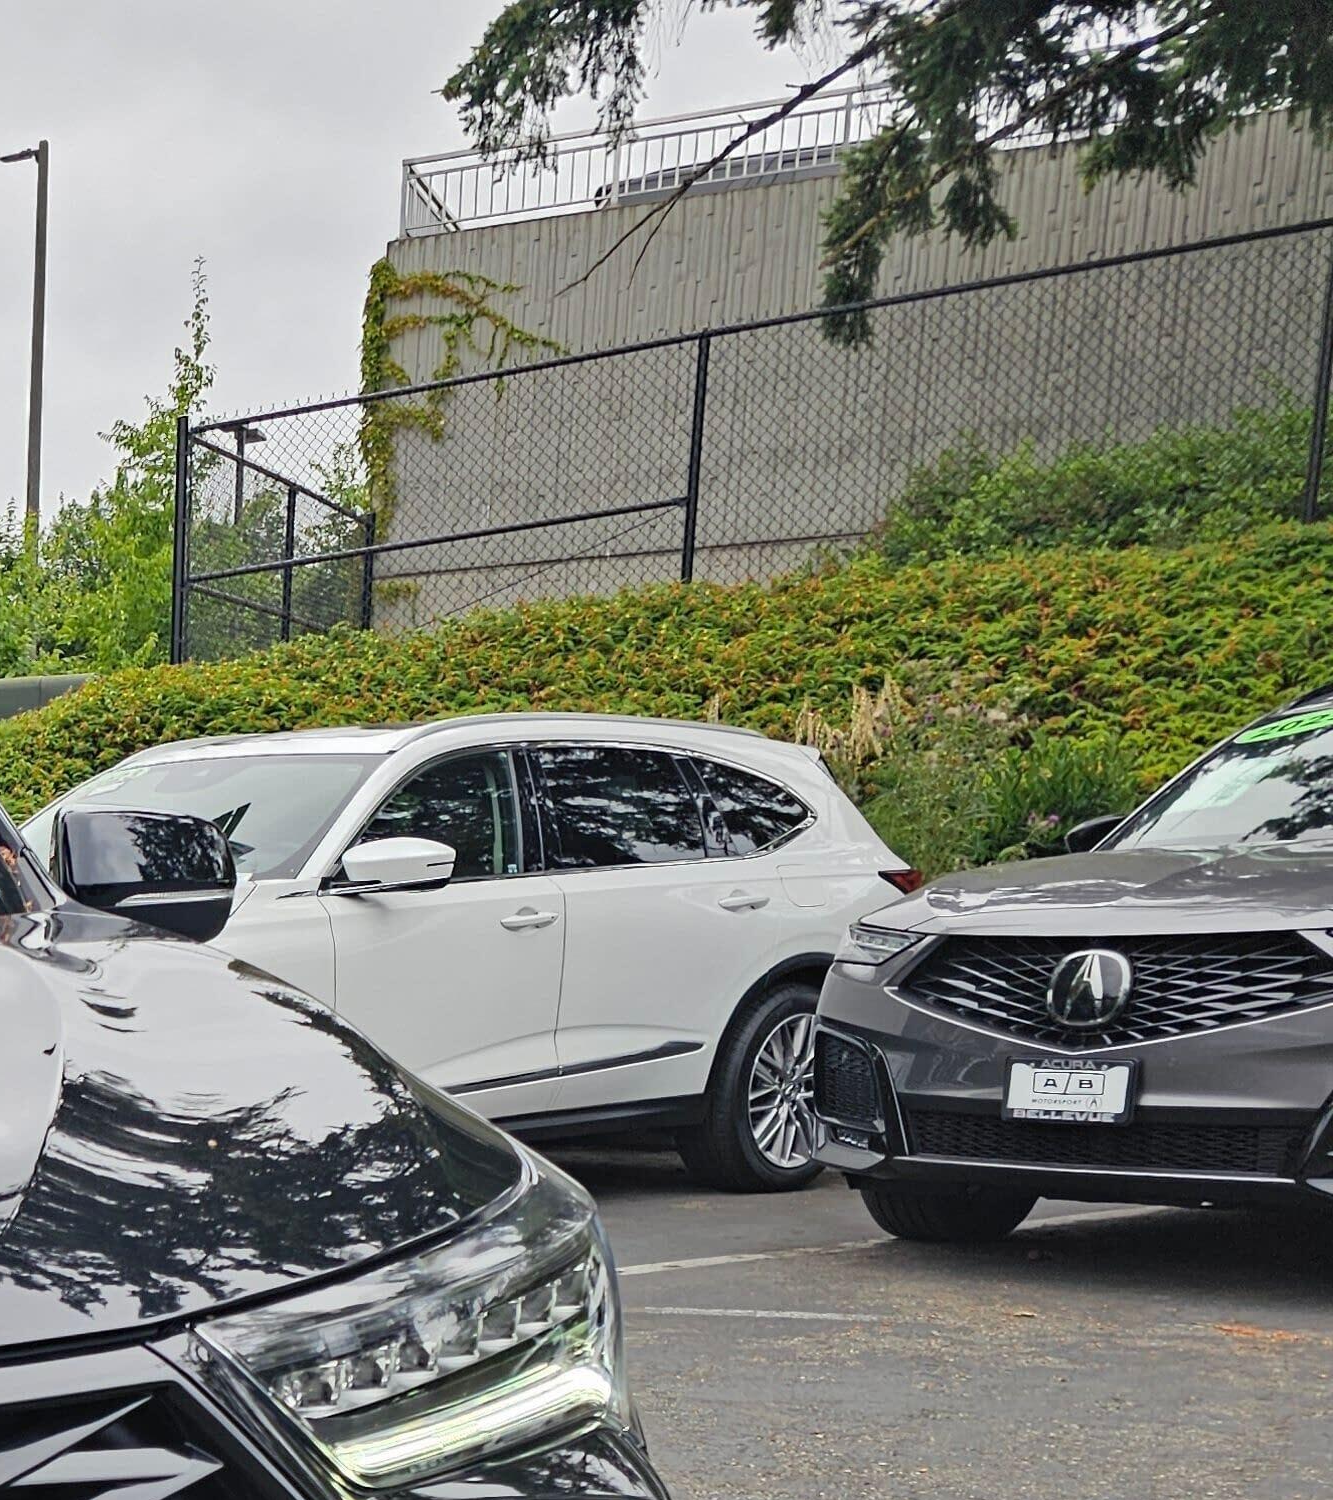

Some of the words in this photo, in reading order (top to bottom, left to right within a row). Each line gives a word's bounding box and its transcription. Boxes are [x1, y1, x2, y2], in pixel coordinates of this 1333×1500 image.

[1249, 713, 1333, 740] 202
[1040, 1059, 1097, 1070] ACURA
[1012, 1108, 1115, 1122] BELLEVUE
